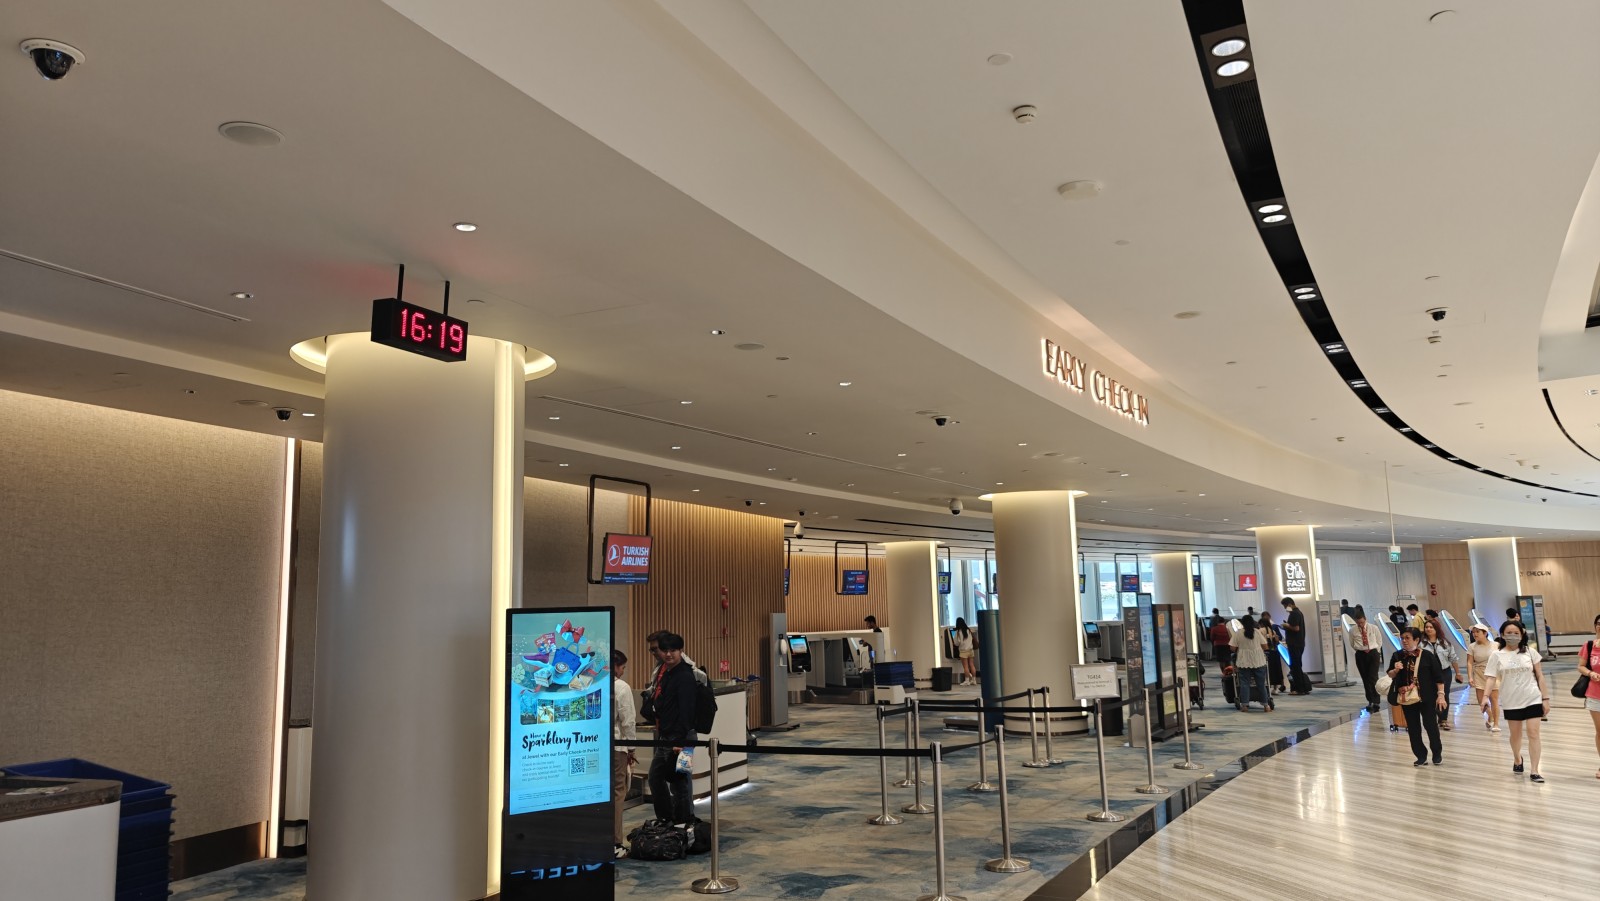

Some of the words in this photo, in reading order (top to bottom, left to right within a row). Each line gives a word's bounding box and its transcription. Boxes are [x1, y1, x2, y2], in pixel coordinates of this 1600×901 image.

[401, 308, 464, 353] 16:19
[1041, 338, 1087, 392] EARLY
[1090, 369, 1149, 425] CHECK-IN
[623, 545, 649, 556] TURKISH
[621, 557, 649, 566] AIRLINES
[1286, 579, 1306, 587] FAST
[522, 730, 572, 752] Sparkling
[572, 731, 599, 744] Time
